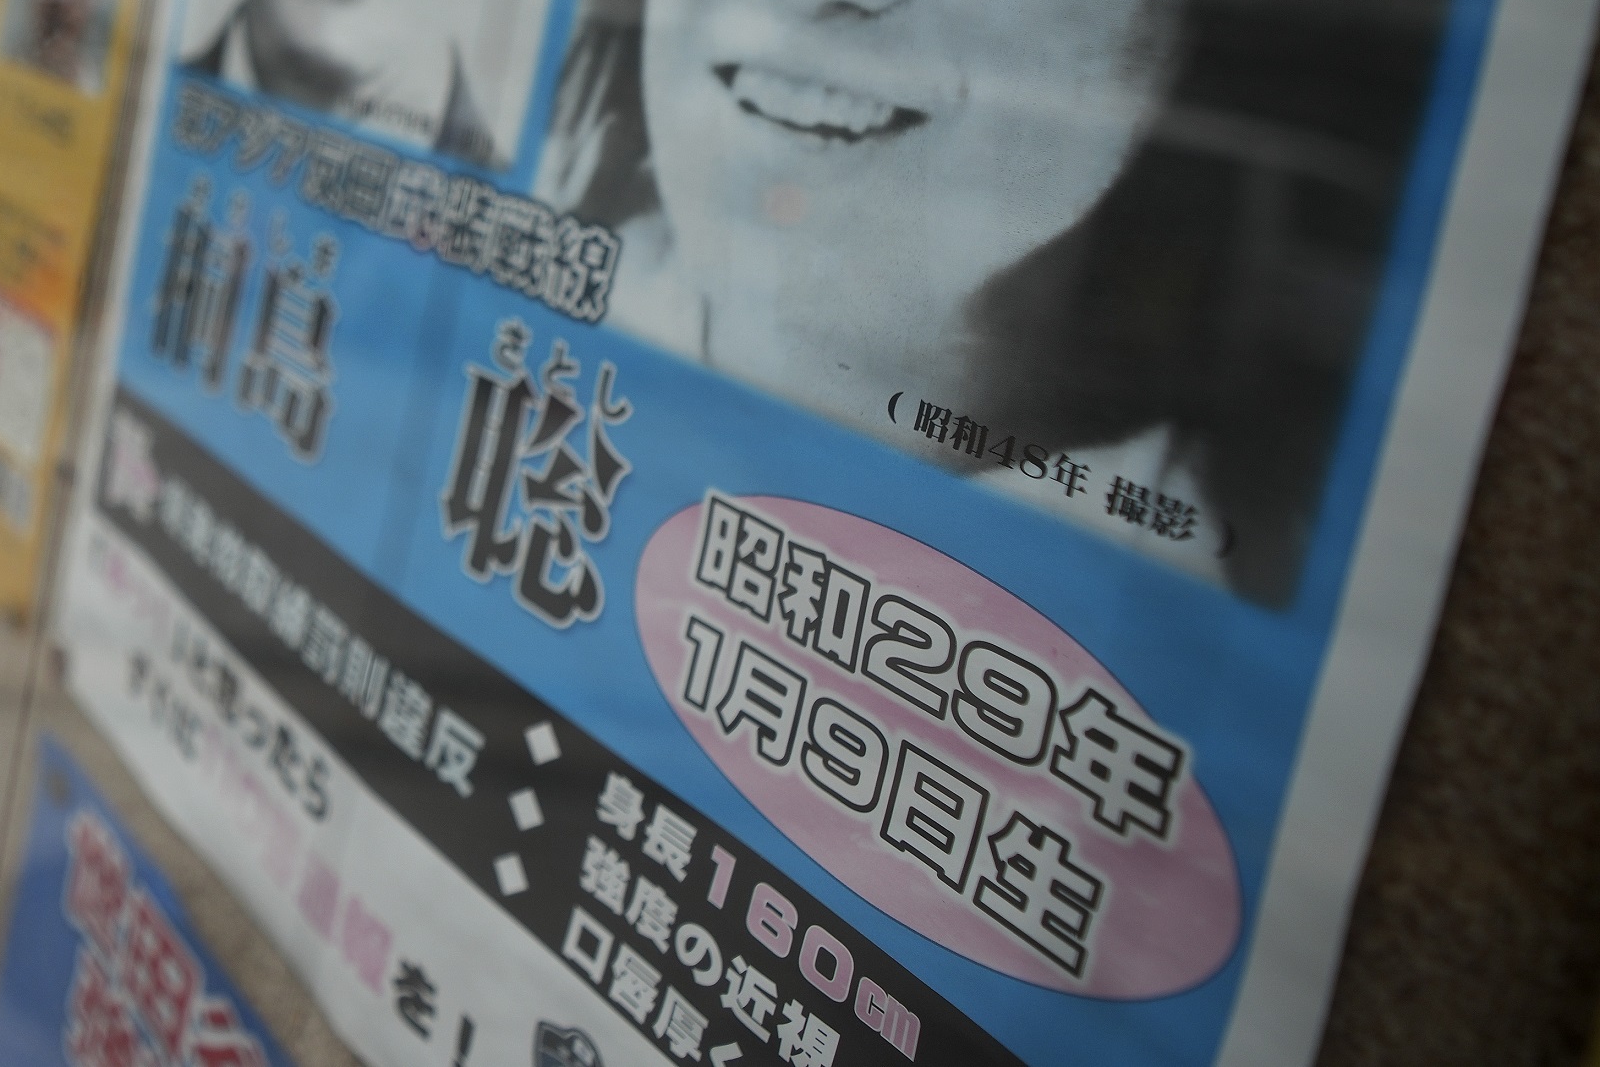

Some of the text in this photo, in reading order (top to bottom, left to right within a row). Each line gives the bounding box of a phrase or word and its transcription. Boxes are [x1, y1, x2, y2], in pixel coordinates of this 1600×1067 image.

[683, 616, 1104, 979] 1月9日生
[696, 496, 1185, 840] 昭和29年
